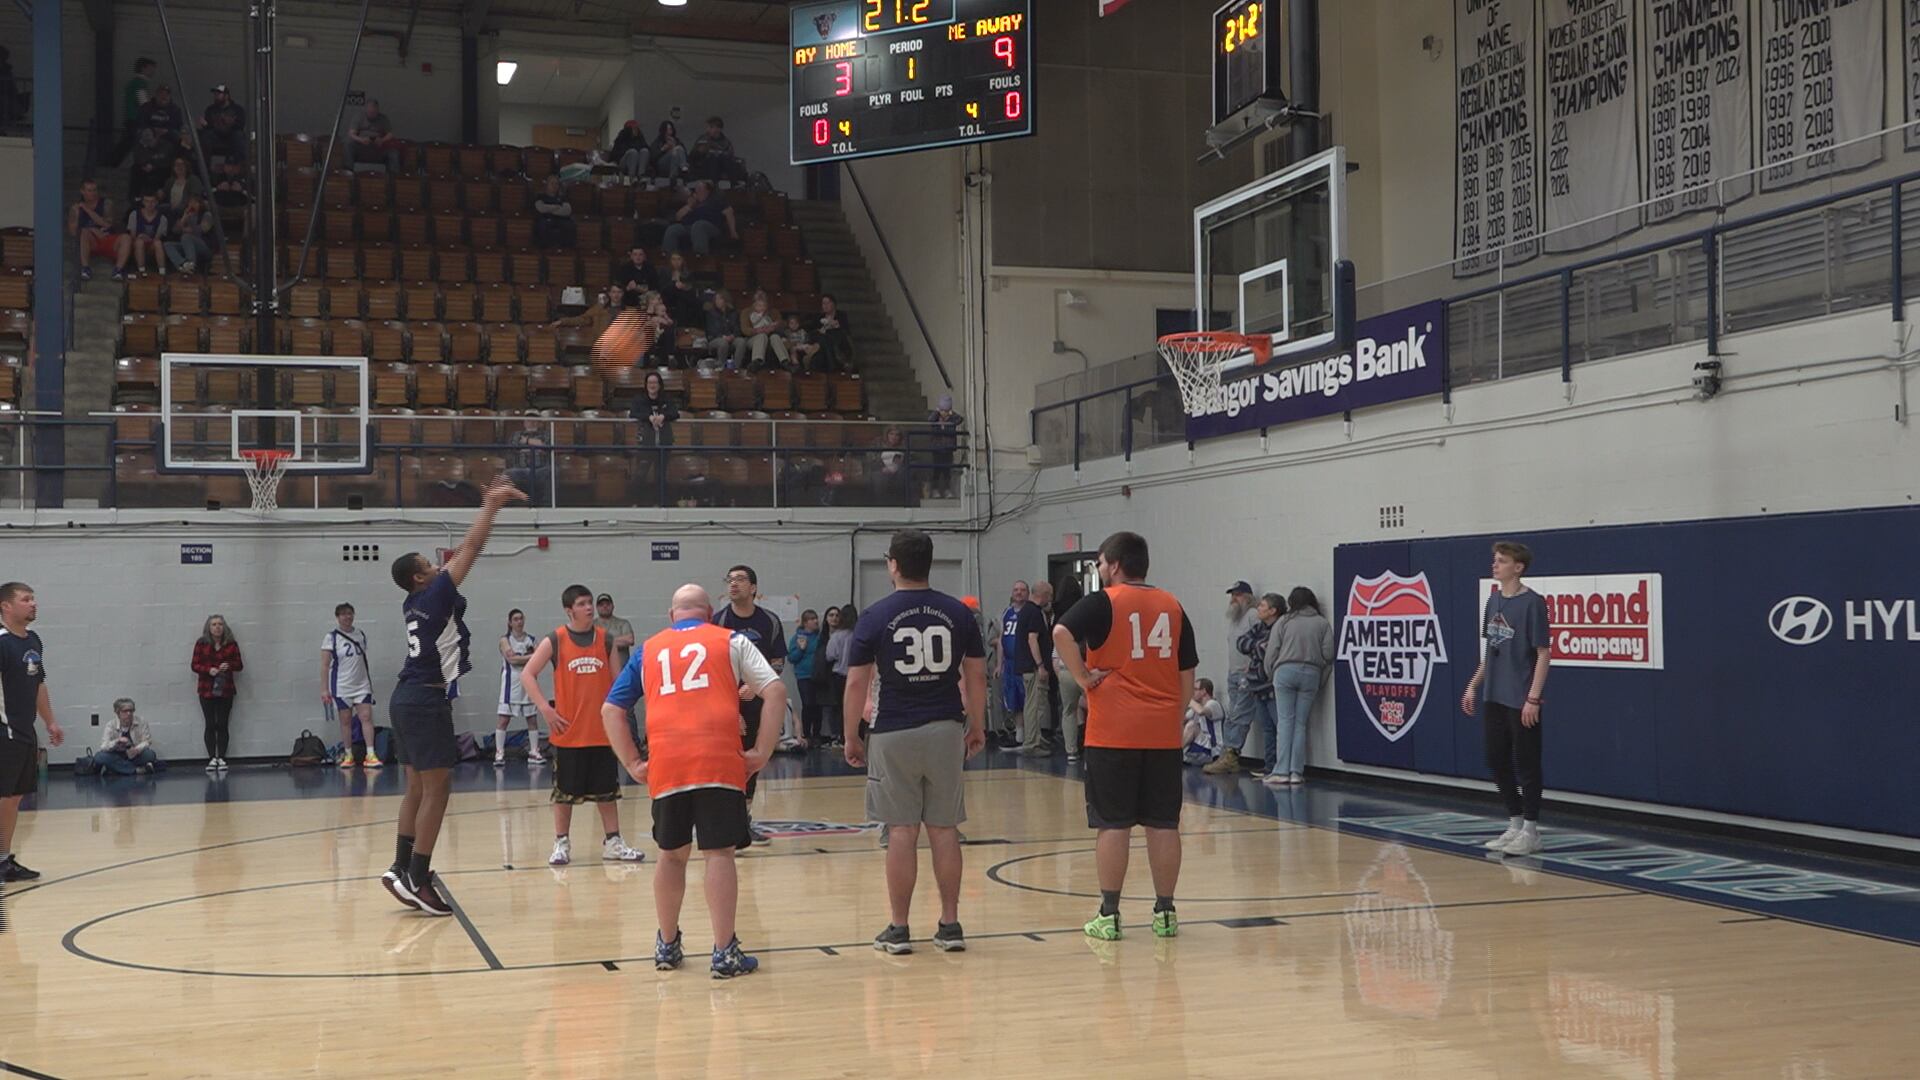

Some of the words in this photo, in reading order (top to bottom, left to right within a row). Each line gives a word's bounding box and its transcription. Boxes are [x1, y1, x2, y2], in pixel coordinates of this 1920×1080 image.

[976, 14, 1022, 37] AWAY
[825, 40, 857, 59] HOME
[889, 39, 923, 54] PERIOD
[994, 37, 1013, 68] 9
[835, 62, 852, 97] 3
[907, 58, 915, 80] 1
[989, 75, 1021, 90] FOULS
[869, 92, 892, 107] PLYR
[900, 90, 924, 103] FOUL
[935, 84, 953, 98] PTS
[800, 102, 828, 118] FOULS
[966, 102, 978, 118] 4
[838, 120, 850, 136] 4
[959, 124, 985, 137] T.O.L.
[832, 142, 857, 154] T.O.L.
[1262, 353, 1352, 402] Savings
[1129, 612, 1172, 659] 14
[1342, 619, 1442, 658] AMERICA
[1558, 630, 1644, 662] Company
[893, 625, 952, 674] 30
[657, 642, 709, 695] 12
[1363, 651, 1418, 679] EAST
[1366, 684, 1417, 698] PLAYOFFS
